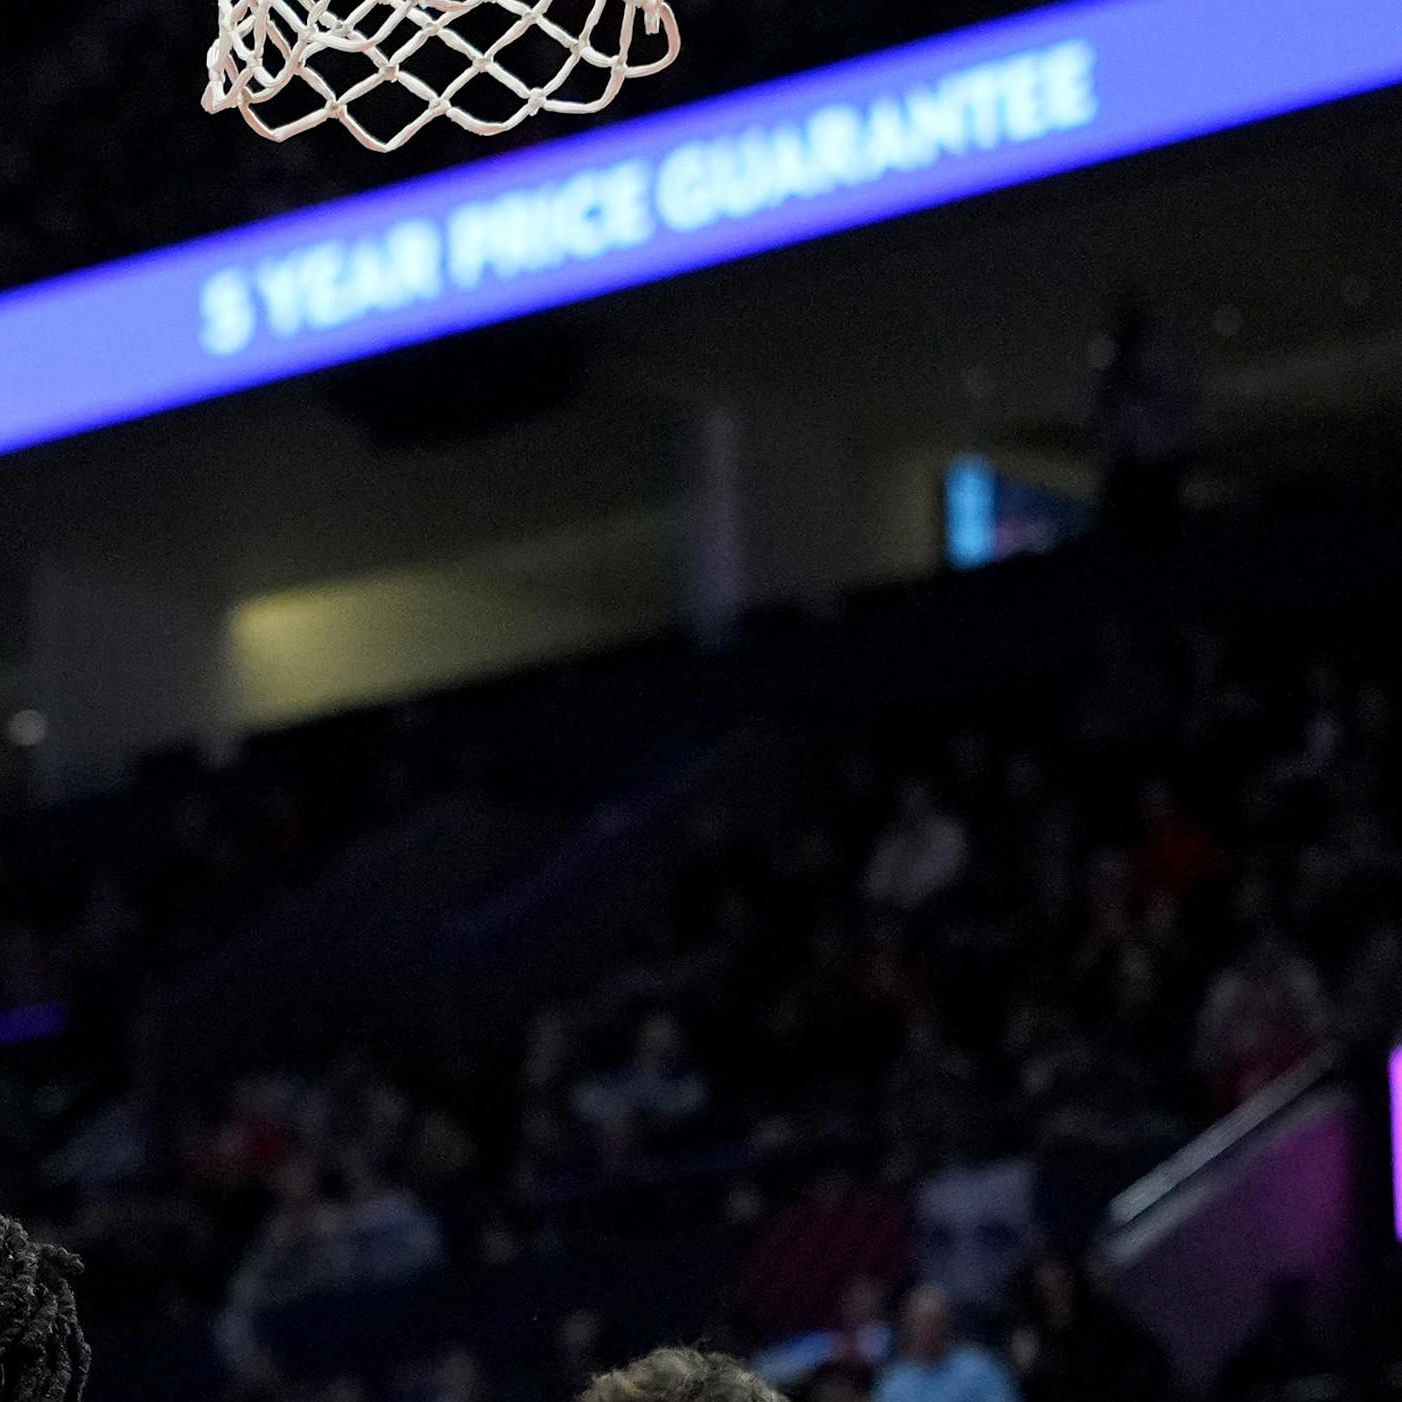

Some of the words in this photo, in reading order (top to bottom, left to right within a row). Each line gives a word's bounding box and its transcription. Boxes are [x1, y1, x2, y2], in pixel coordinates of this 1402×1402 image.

[256, 219, 443, 337] YEAR
[447, 156, 654, 287] PRICE
[657, 39, 1099, 232] GUARANTEE
